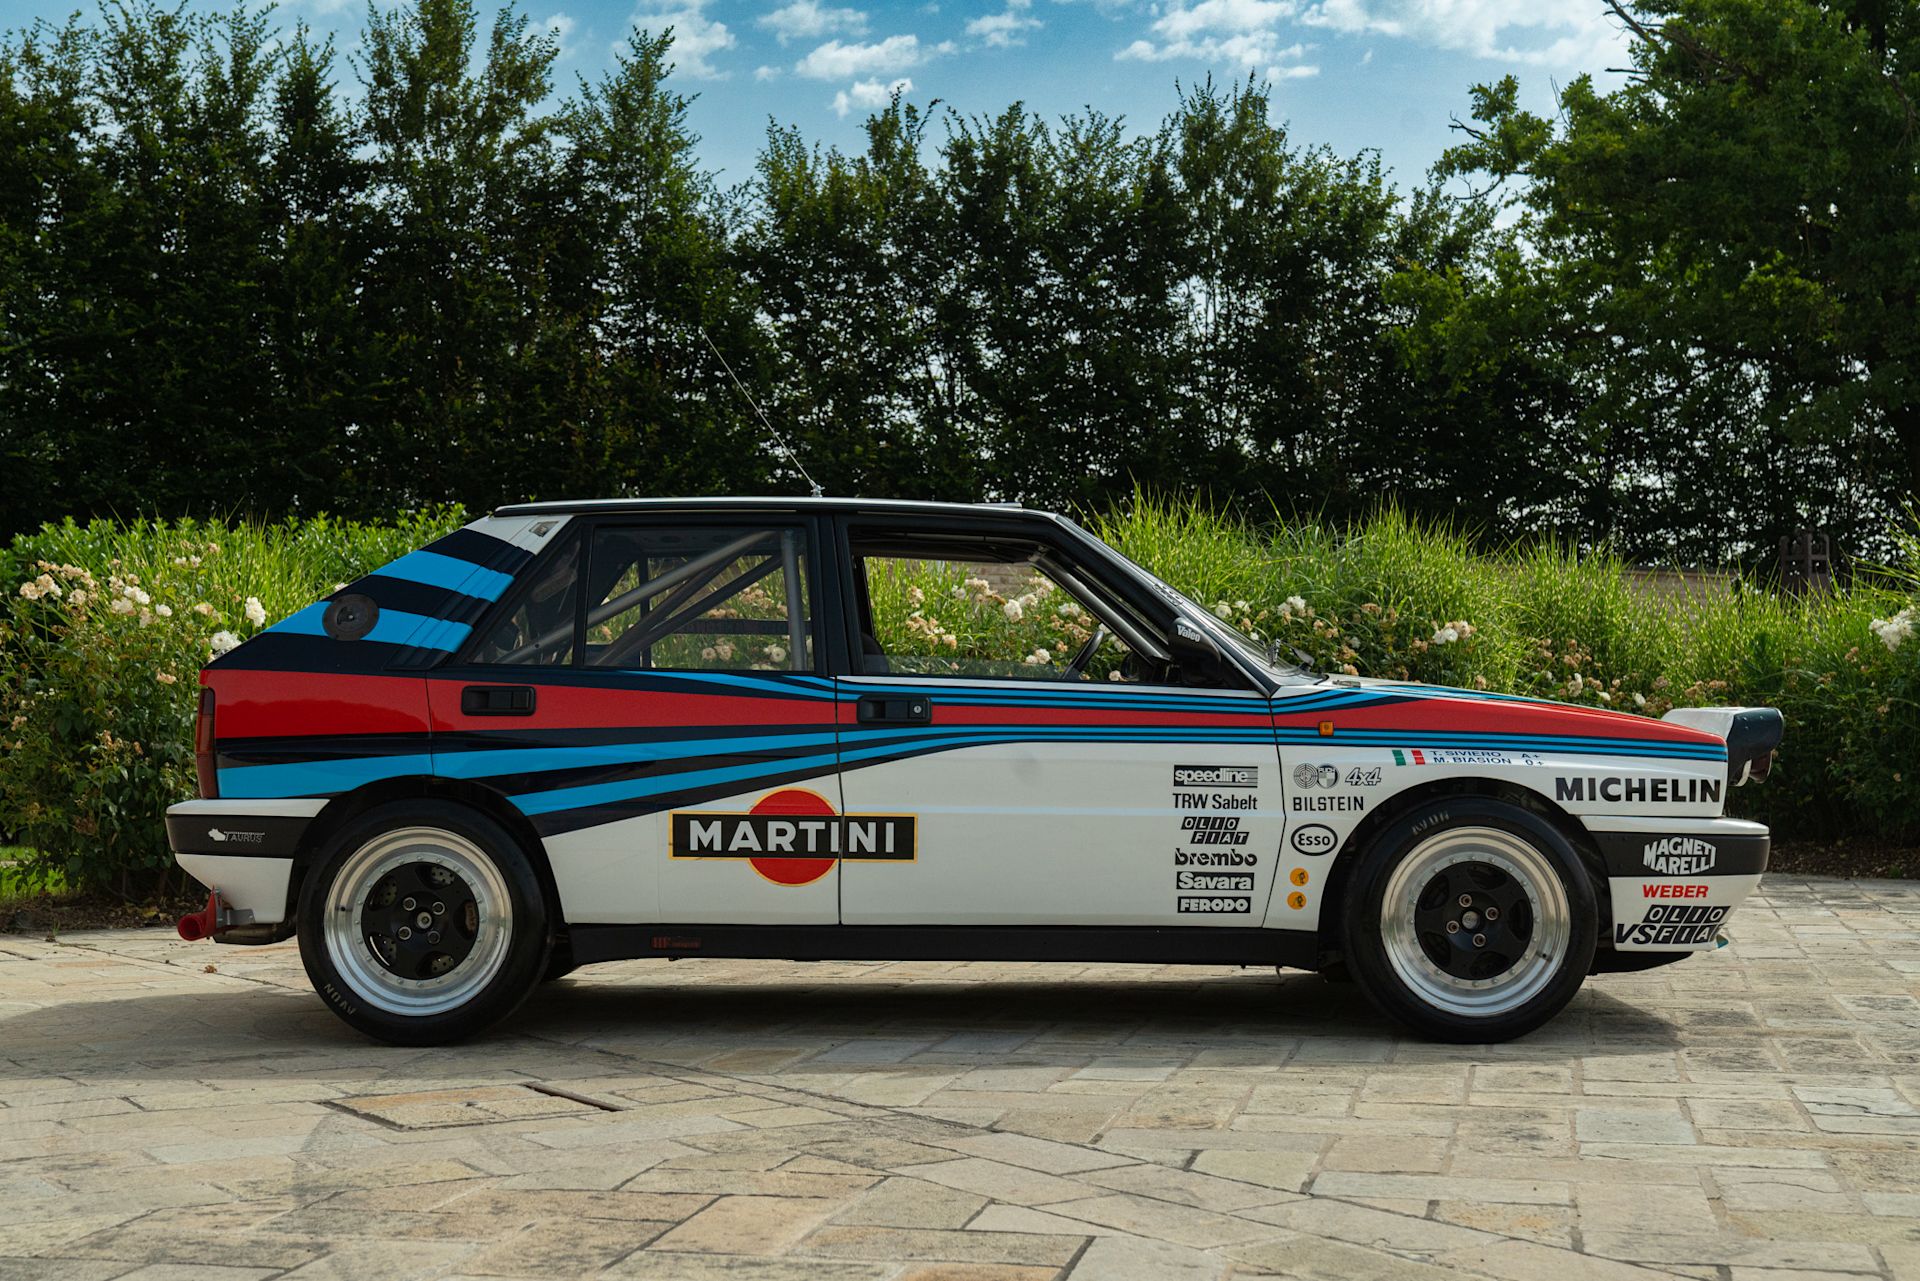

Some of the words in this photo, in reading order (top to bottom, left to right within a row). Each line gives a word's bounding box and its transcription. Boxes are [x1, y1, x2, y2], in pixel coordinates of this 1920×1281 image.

[1177, 624, 1201, 642] Valeo
[1175, 768, 1249, 785] speedline
[1345, 767, 1382, 786] 4x4
[1555, 777, 1721, 803] MICHELIN
[1172, 793, 1209, 809] TRW
[1212, 794, 1258, 810] Sabelt
[1293, 796, 1364, 812] BILSTEIN
[1184, 818, 1237, 829] OLIO
[224, 831, 266, 843] TAURUS
[689, 820, 896, 853] MARTINI
[1194, 833, 1247, 843] FIAT
[1298, 833, 1330, 846] Esso
[1175, 848, 1258, 867] brembo
[1643, 837, 1717, 868] MAGNETI
[1643, 846, 1717, 875] MARELLI
[1178, 871, 1252, 890] Savara
[1642, 884, 1709, 898] WEBER
[1180, 898, 1249, 912] FERODO
[1649, 907, 1724, 922] OLIO
[1616, 923, 1657, 944] VS
[1658, 925, 1719, 942] FIA
